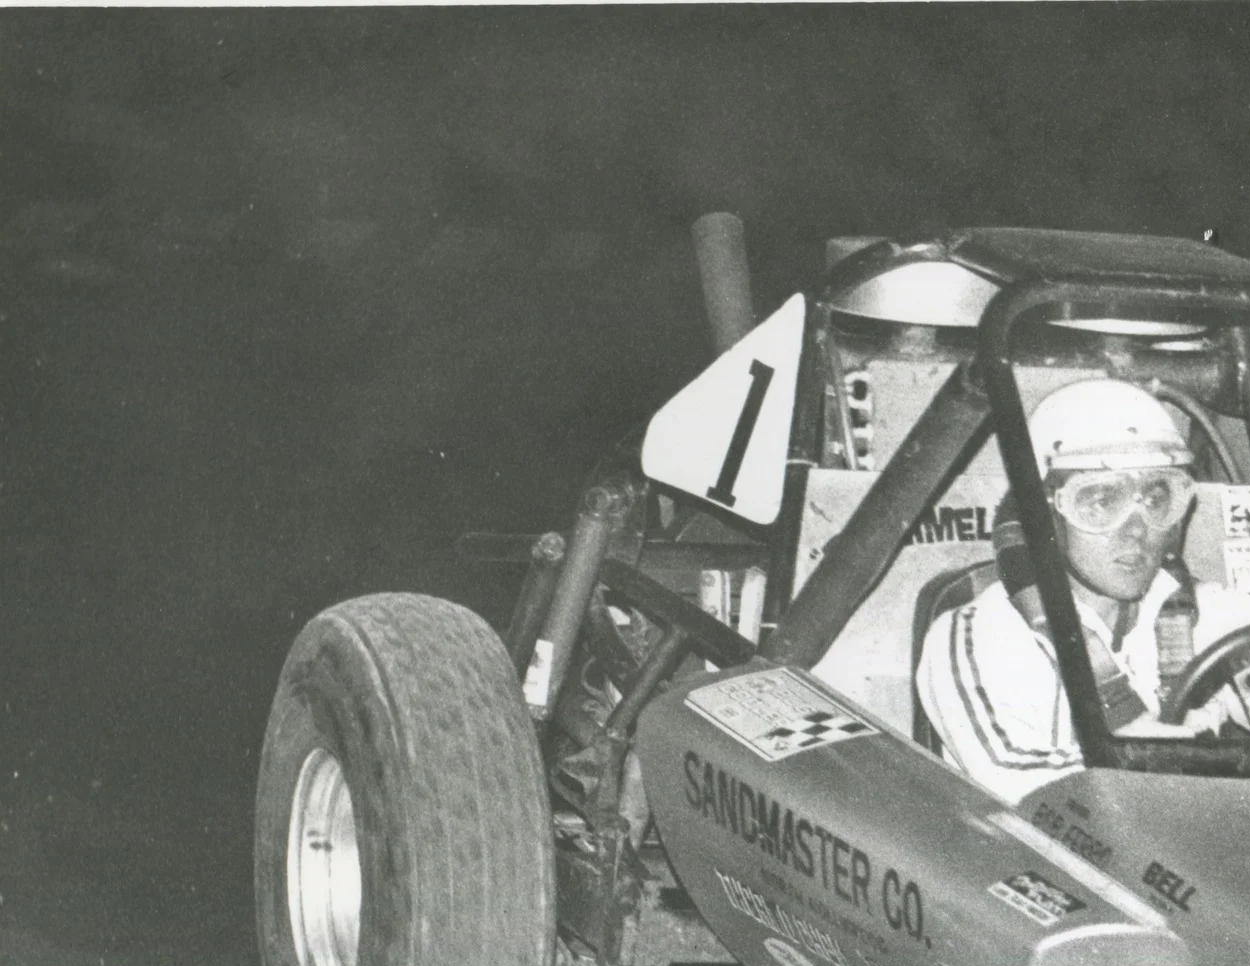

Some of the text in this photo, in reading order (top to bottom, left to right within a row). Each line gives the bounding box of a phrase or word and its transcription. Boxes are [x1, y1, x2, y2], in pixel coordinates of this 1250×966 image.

[705, 358, 775, 508] 1
[683, 750, 873, 917] SANDMASTER
[882, 868, 932, 950] CO.
[1142, 861, 1197, 913] BELL
